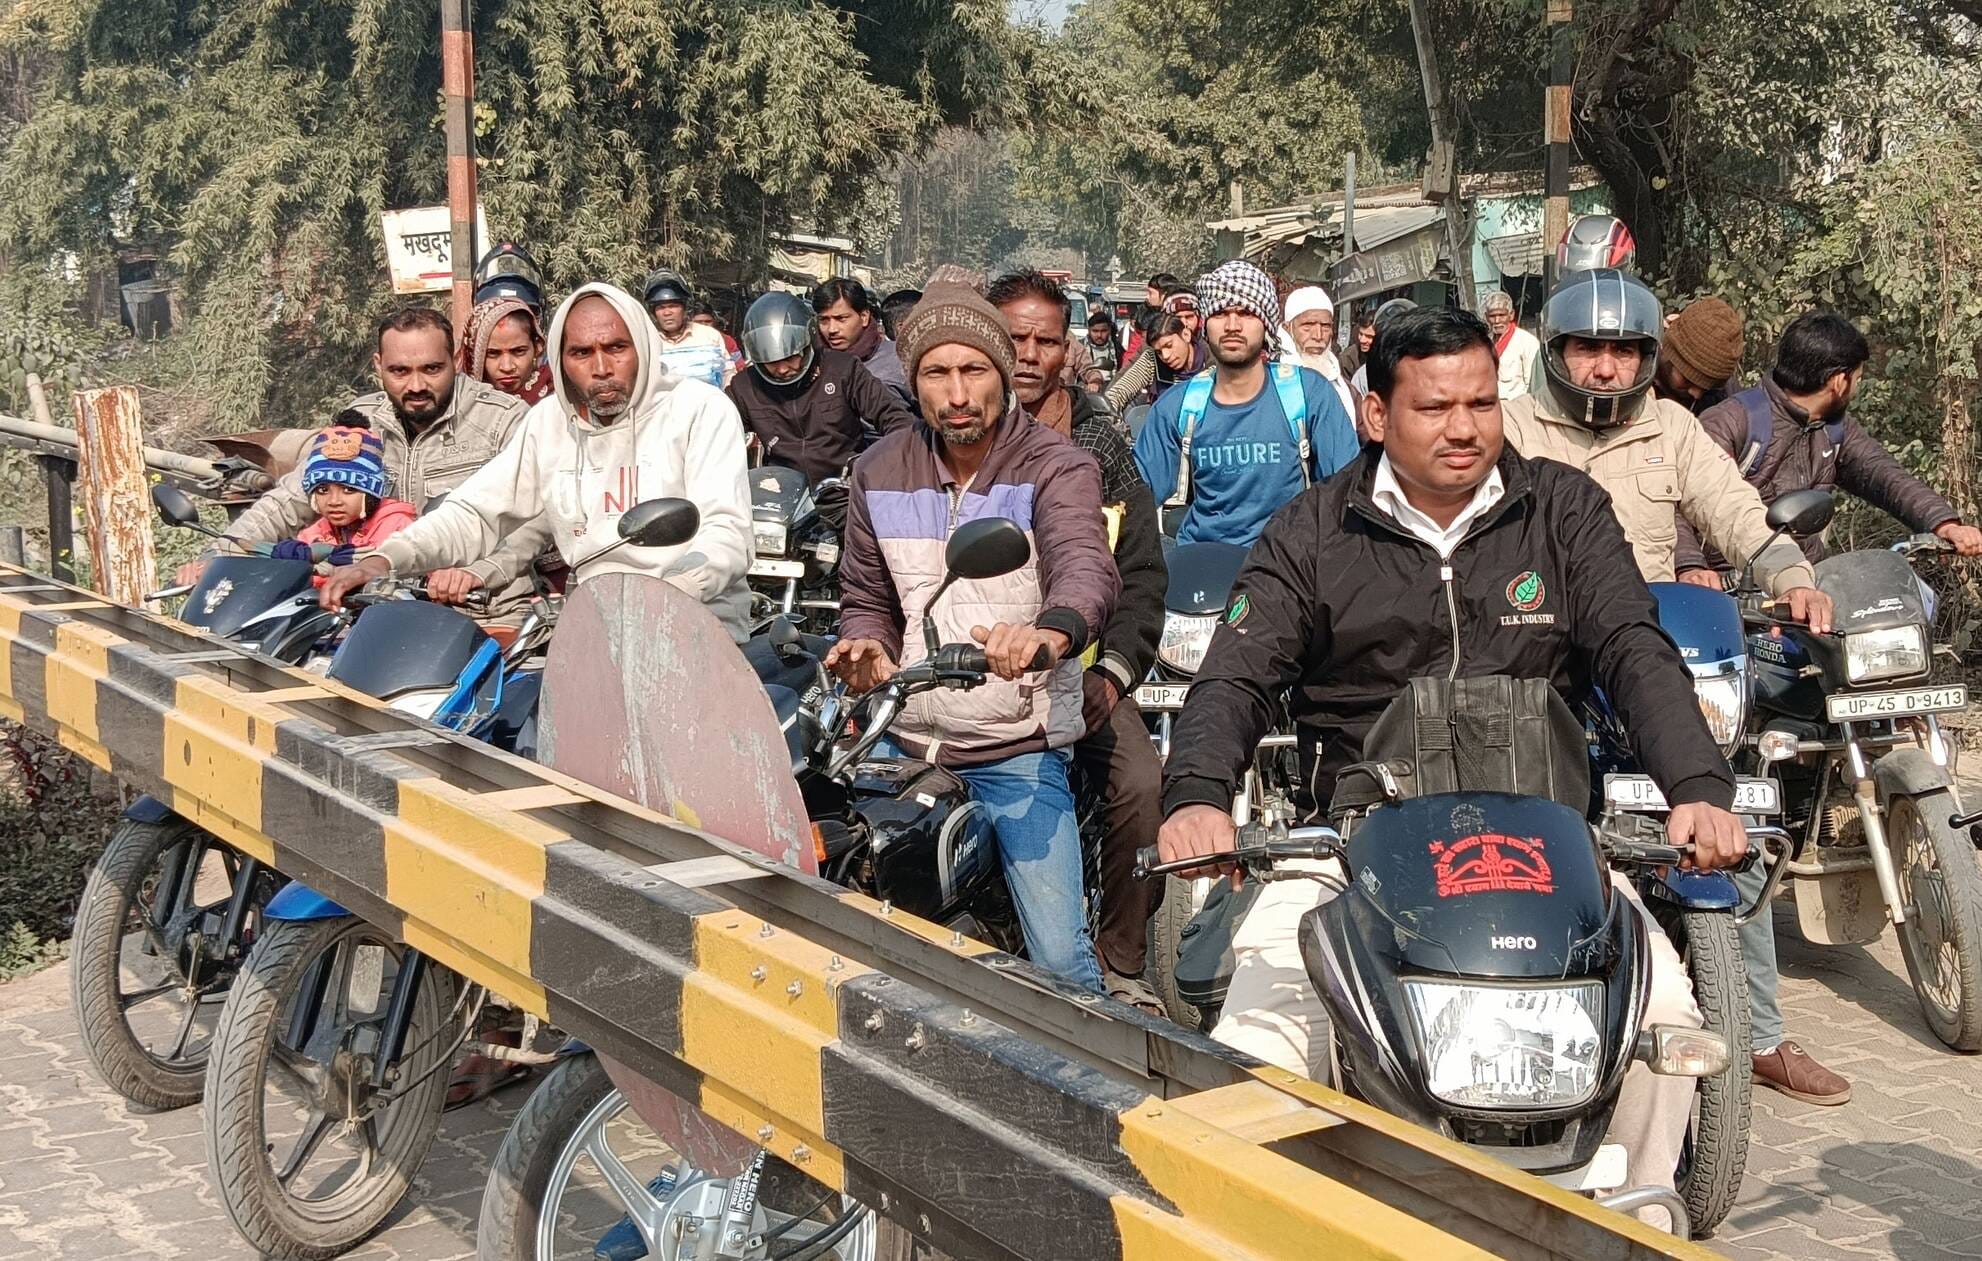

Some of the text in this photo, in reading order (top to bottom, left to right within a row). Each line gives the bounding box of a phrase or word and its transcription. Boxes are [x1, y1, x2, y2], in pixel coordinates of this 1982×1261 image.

[1197, 442, 1281, 468] FUTURE
[1521, 613, 1555, 625] INDUSTRY
[1679, 646, 1700, 657] VS
[1756, 638, 1783, 653] HERO
[1754, 647, 1787, 664] HONDA
[1152, 689, 1171, 703] UP
[1848, 699, 1867, 714] UP
[1632, 783, 1654, 800] UP
[963, 834, 978, 858] Hero
[1491, 936, 1537, 950] Hero
[744, 1172, 760, 1212] HERO
